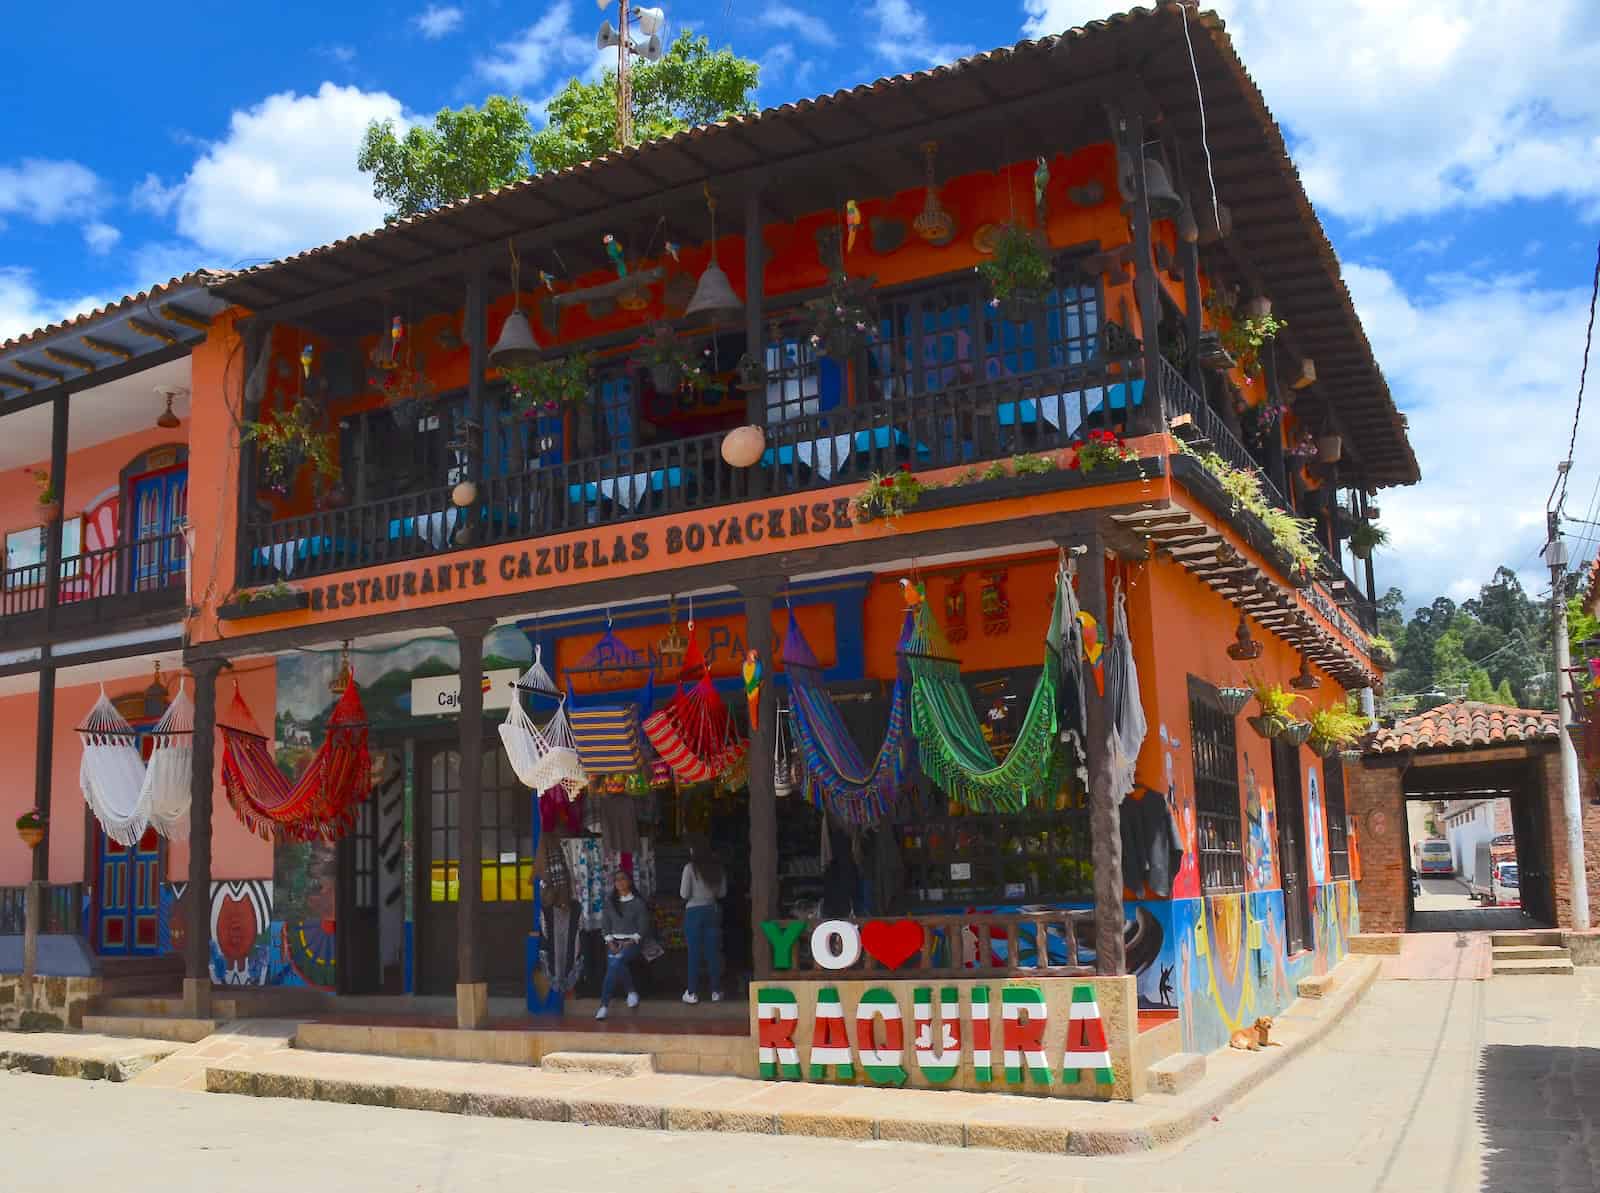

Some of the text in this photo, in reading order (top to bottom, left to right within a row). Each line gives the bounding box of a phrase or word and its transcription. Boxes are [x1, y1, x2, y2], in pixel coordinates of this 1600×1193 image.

[312, 498, 869, 612] RESTAURANTE CAZUELAS BOYACENSE
[760, 919, 862, 970] YO
[757, 984, 1116, 1087] RAQUIRA
